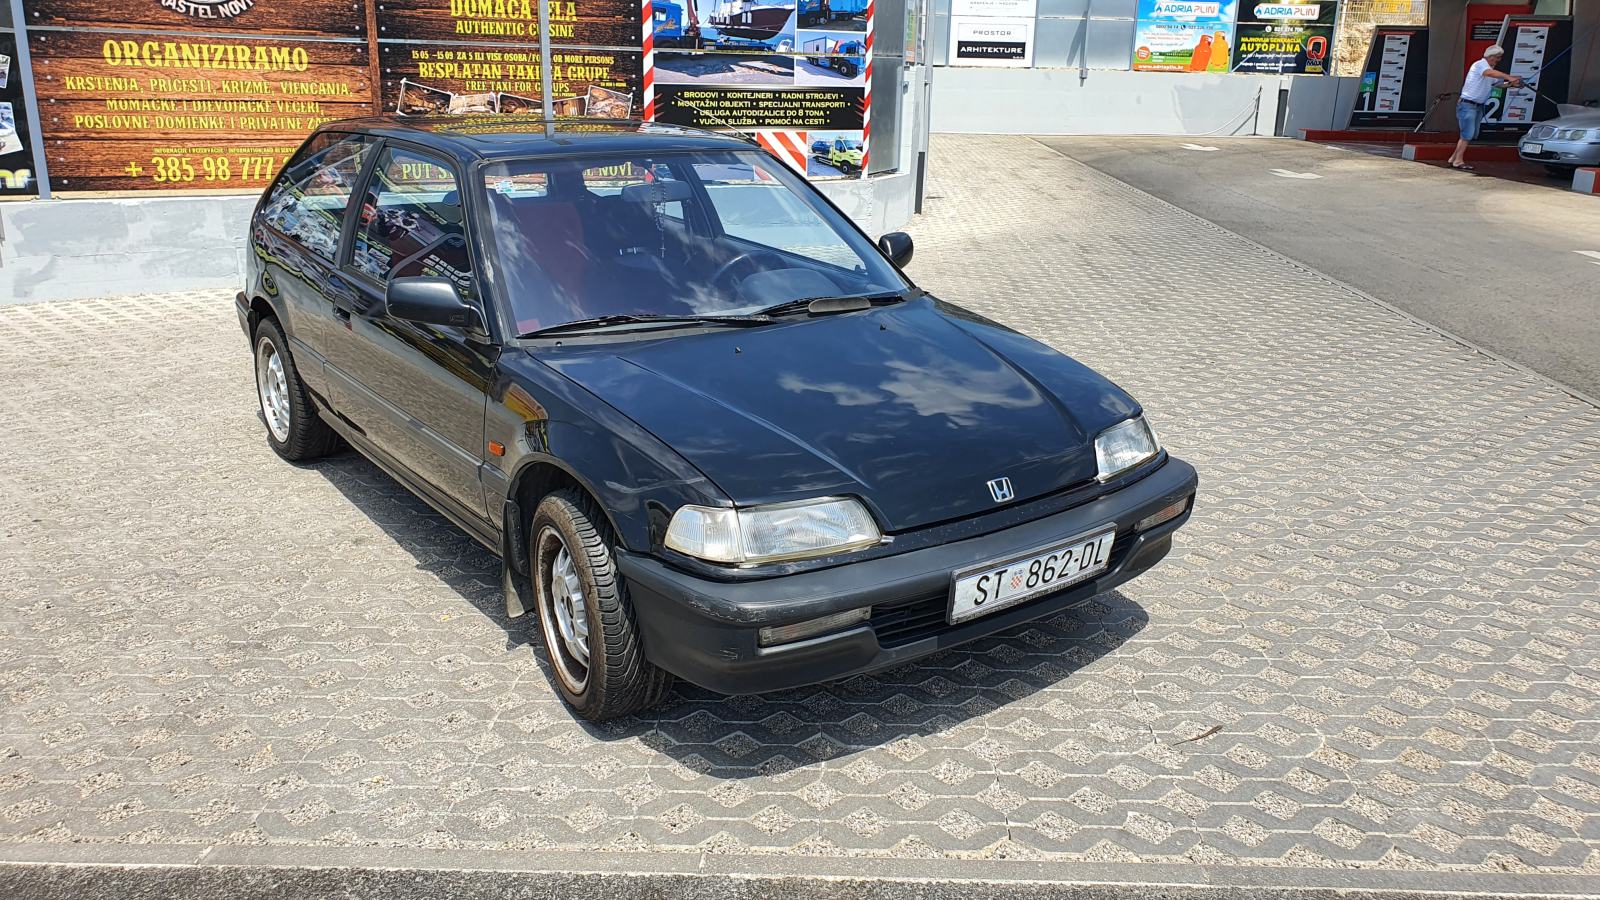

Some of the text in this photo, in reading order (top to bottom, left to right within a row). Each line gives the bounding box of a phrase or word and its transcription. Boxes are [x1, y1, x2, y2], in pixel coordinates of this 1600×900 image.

[161, 0, 217, 19] ASTEL
[547, 1, 578, 21] ELA
[1164, 5, 1216, 14] ADRIA PLIN
[1264, 7, 1316, 16] ADRIA PLIN
[455, 20, 575, 37] AUTHENTIC CSINE
[103, 39, 309, 72] ORGANIZIRAMO
[960, 46, 1023, 54] ARHITEKTURE
[1240, 43, 1300, 52] AUTOPLINA
[456, 51, 467, 60] ZA
[468, 52, 473, 60] 5
[553, 54, 563, 63] OR
[564, 55, 584, 63] MORE
[585, 55, 614, 64] PERSONS
[418, 62, 502, 79] BESPLATAN
[507, 64, 540, 80] TAXI
[567, 65, 610, 81] GRUPE
[465, 81, 570, 92] FREE TAXI FOR GUPS
[1362, 92, 1371, 111] 1
[1483, 98, 1501, 122] 2
[74, 114, 151, 129] POSLOVNE
[230, 116, 235, 129] I
[240, 117, 303, 130] PRIVATNE
[728, 117, 757, 125] SLUŽBA
[765, 117, 791, 125] POMOĆ
[152, 156, 195, 182] 385
[202, 156, 231, 181] 98
[238, 156, 274, 181] 777
[401, 163, 432, 180] PUT
[974, 569, 1008, 606] ST
[1025, 538, 1103, 588] 862-DL
